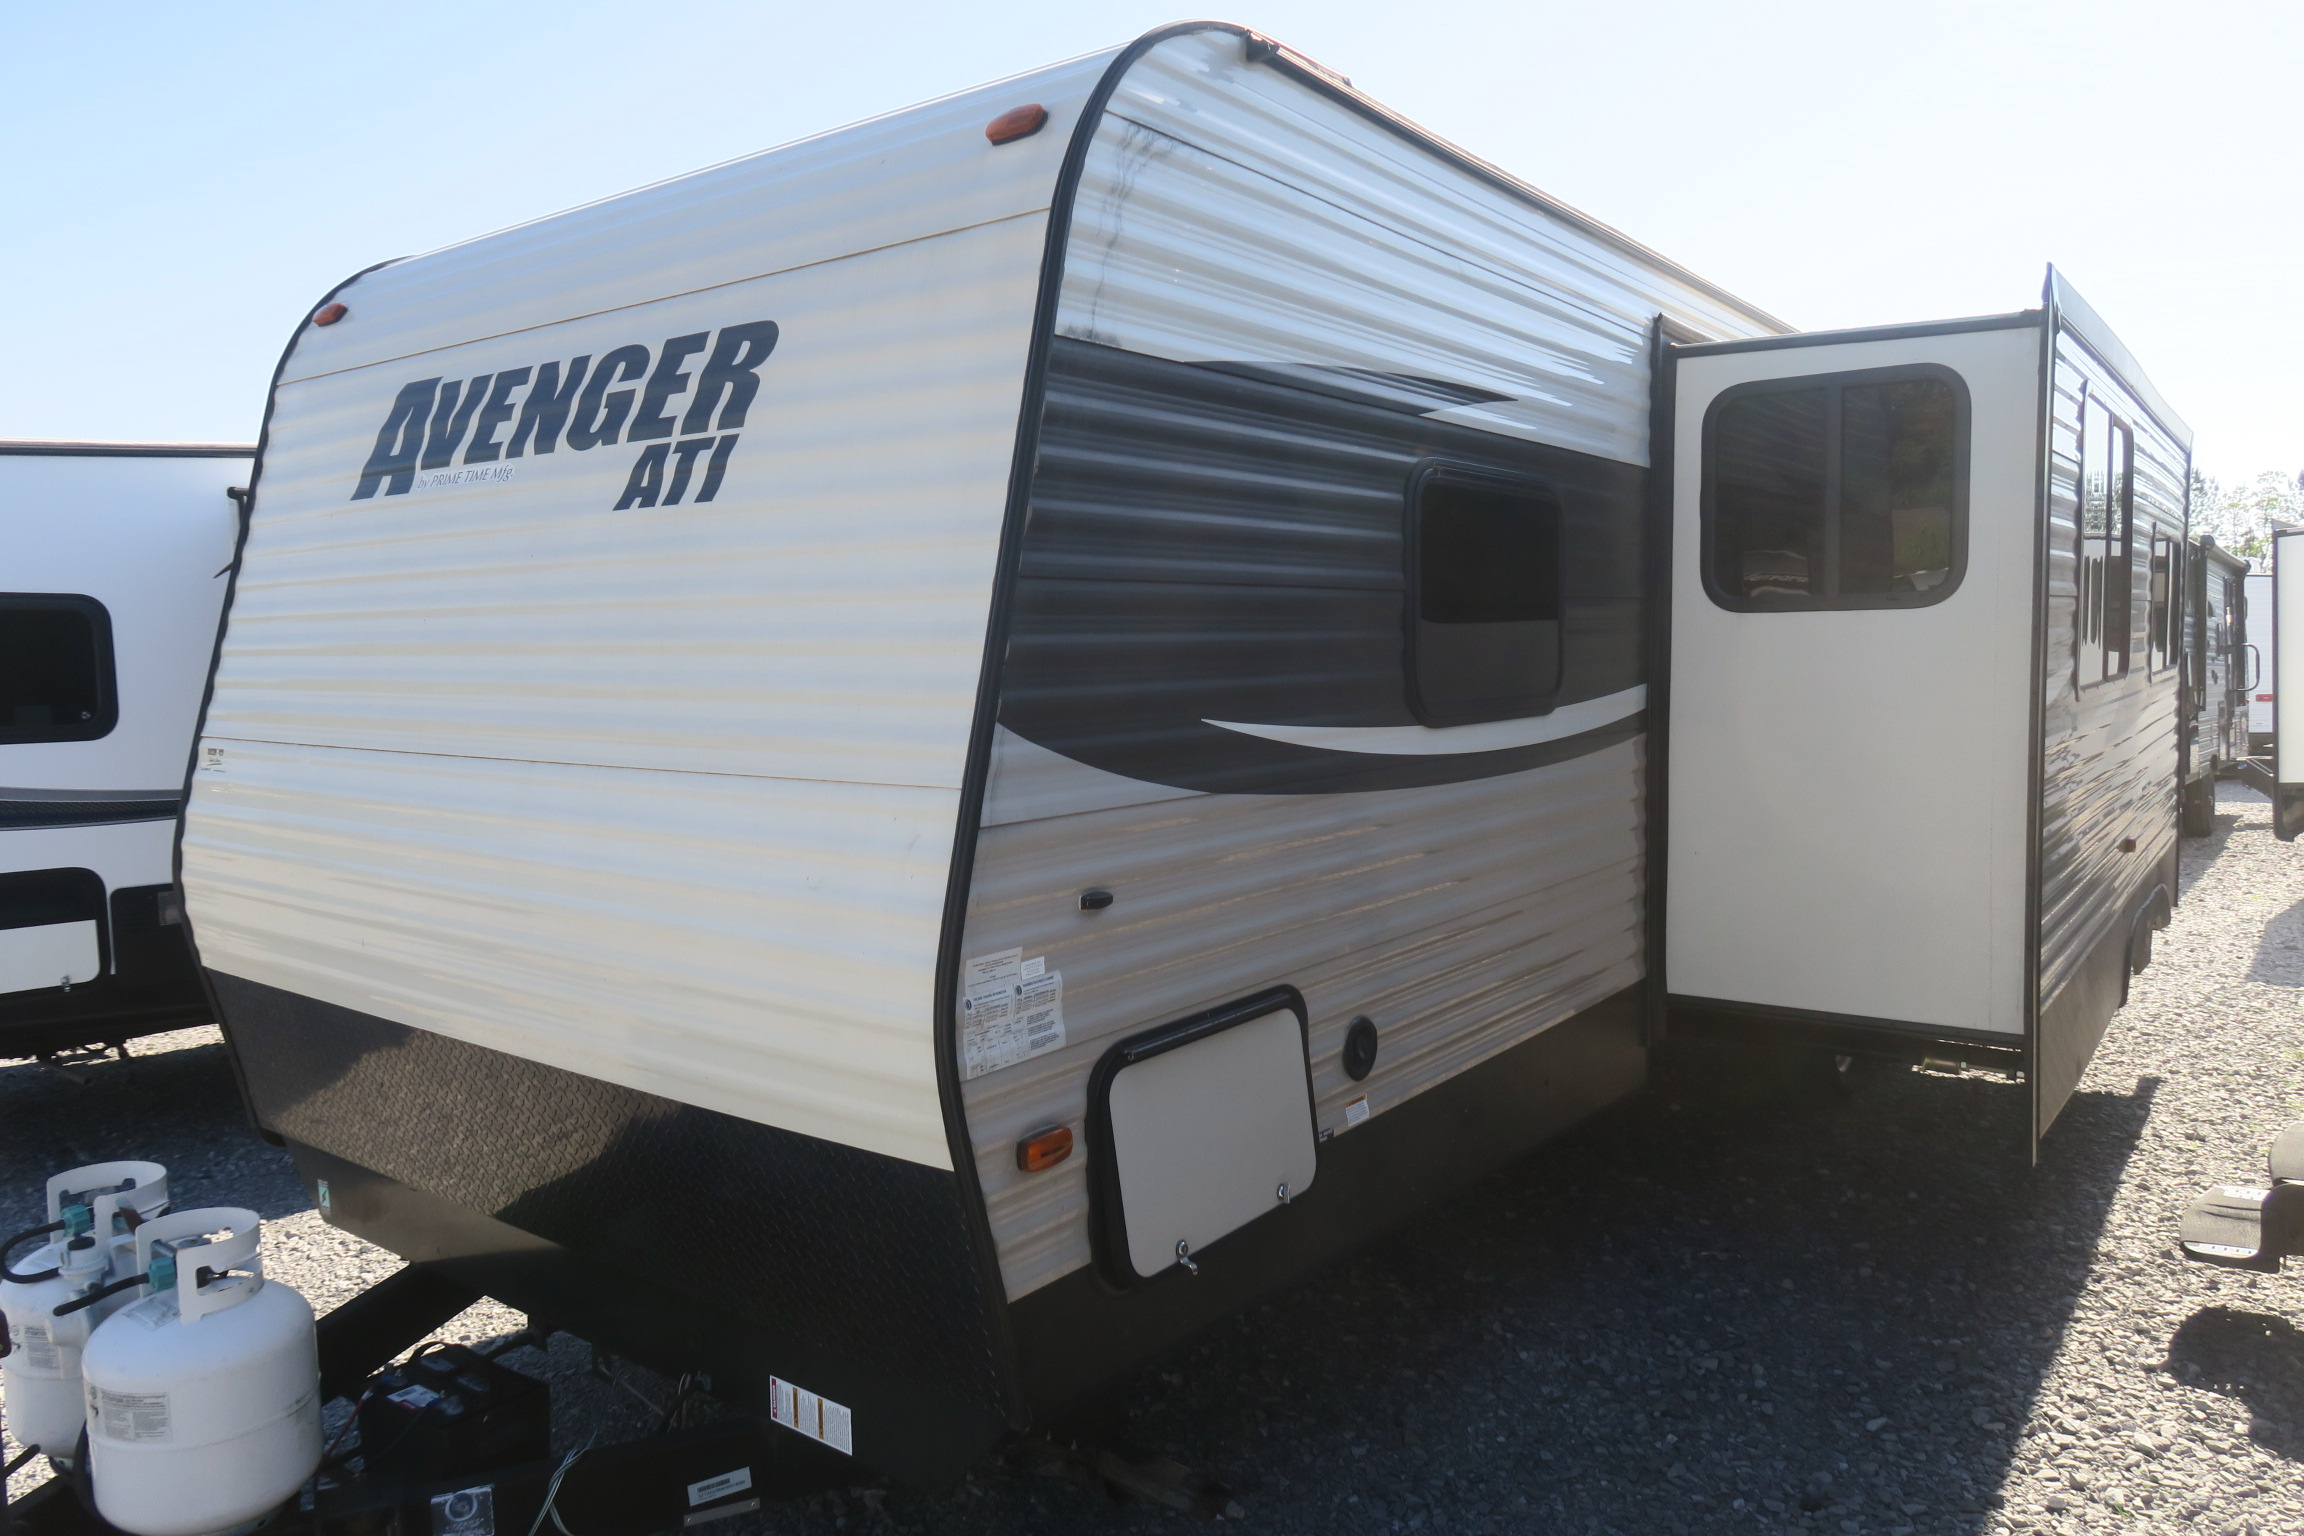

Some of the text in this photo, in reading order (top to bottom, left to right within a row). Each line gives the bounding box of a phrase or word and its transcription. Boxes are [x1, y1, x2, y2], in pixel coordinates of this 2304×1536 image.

[350, 320, 780, 501] AVENGER
[418, 464, 513, 490] by PRIME TIME Mfg.
[612, 433, 740, 511] ATI
